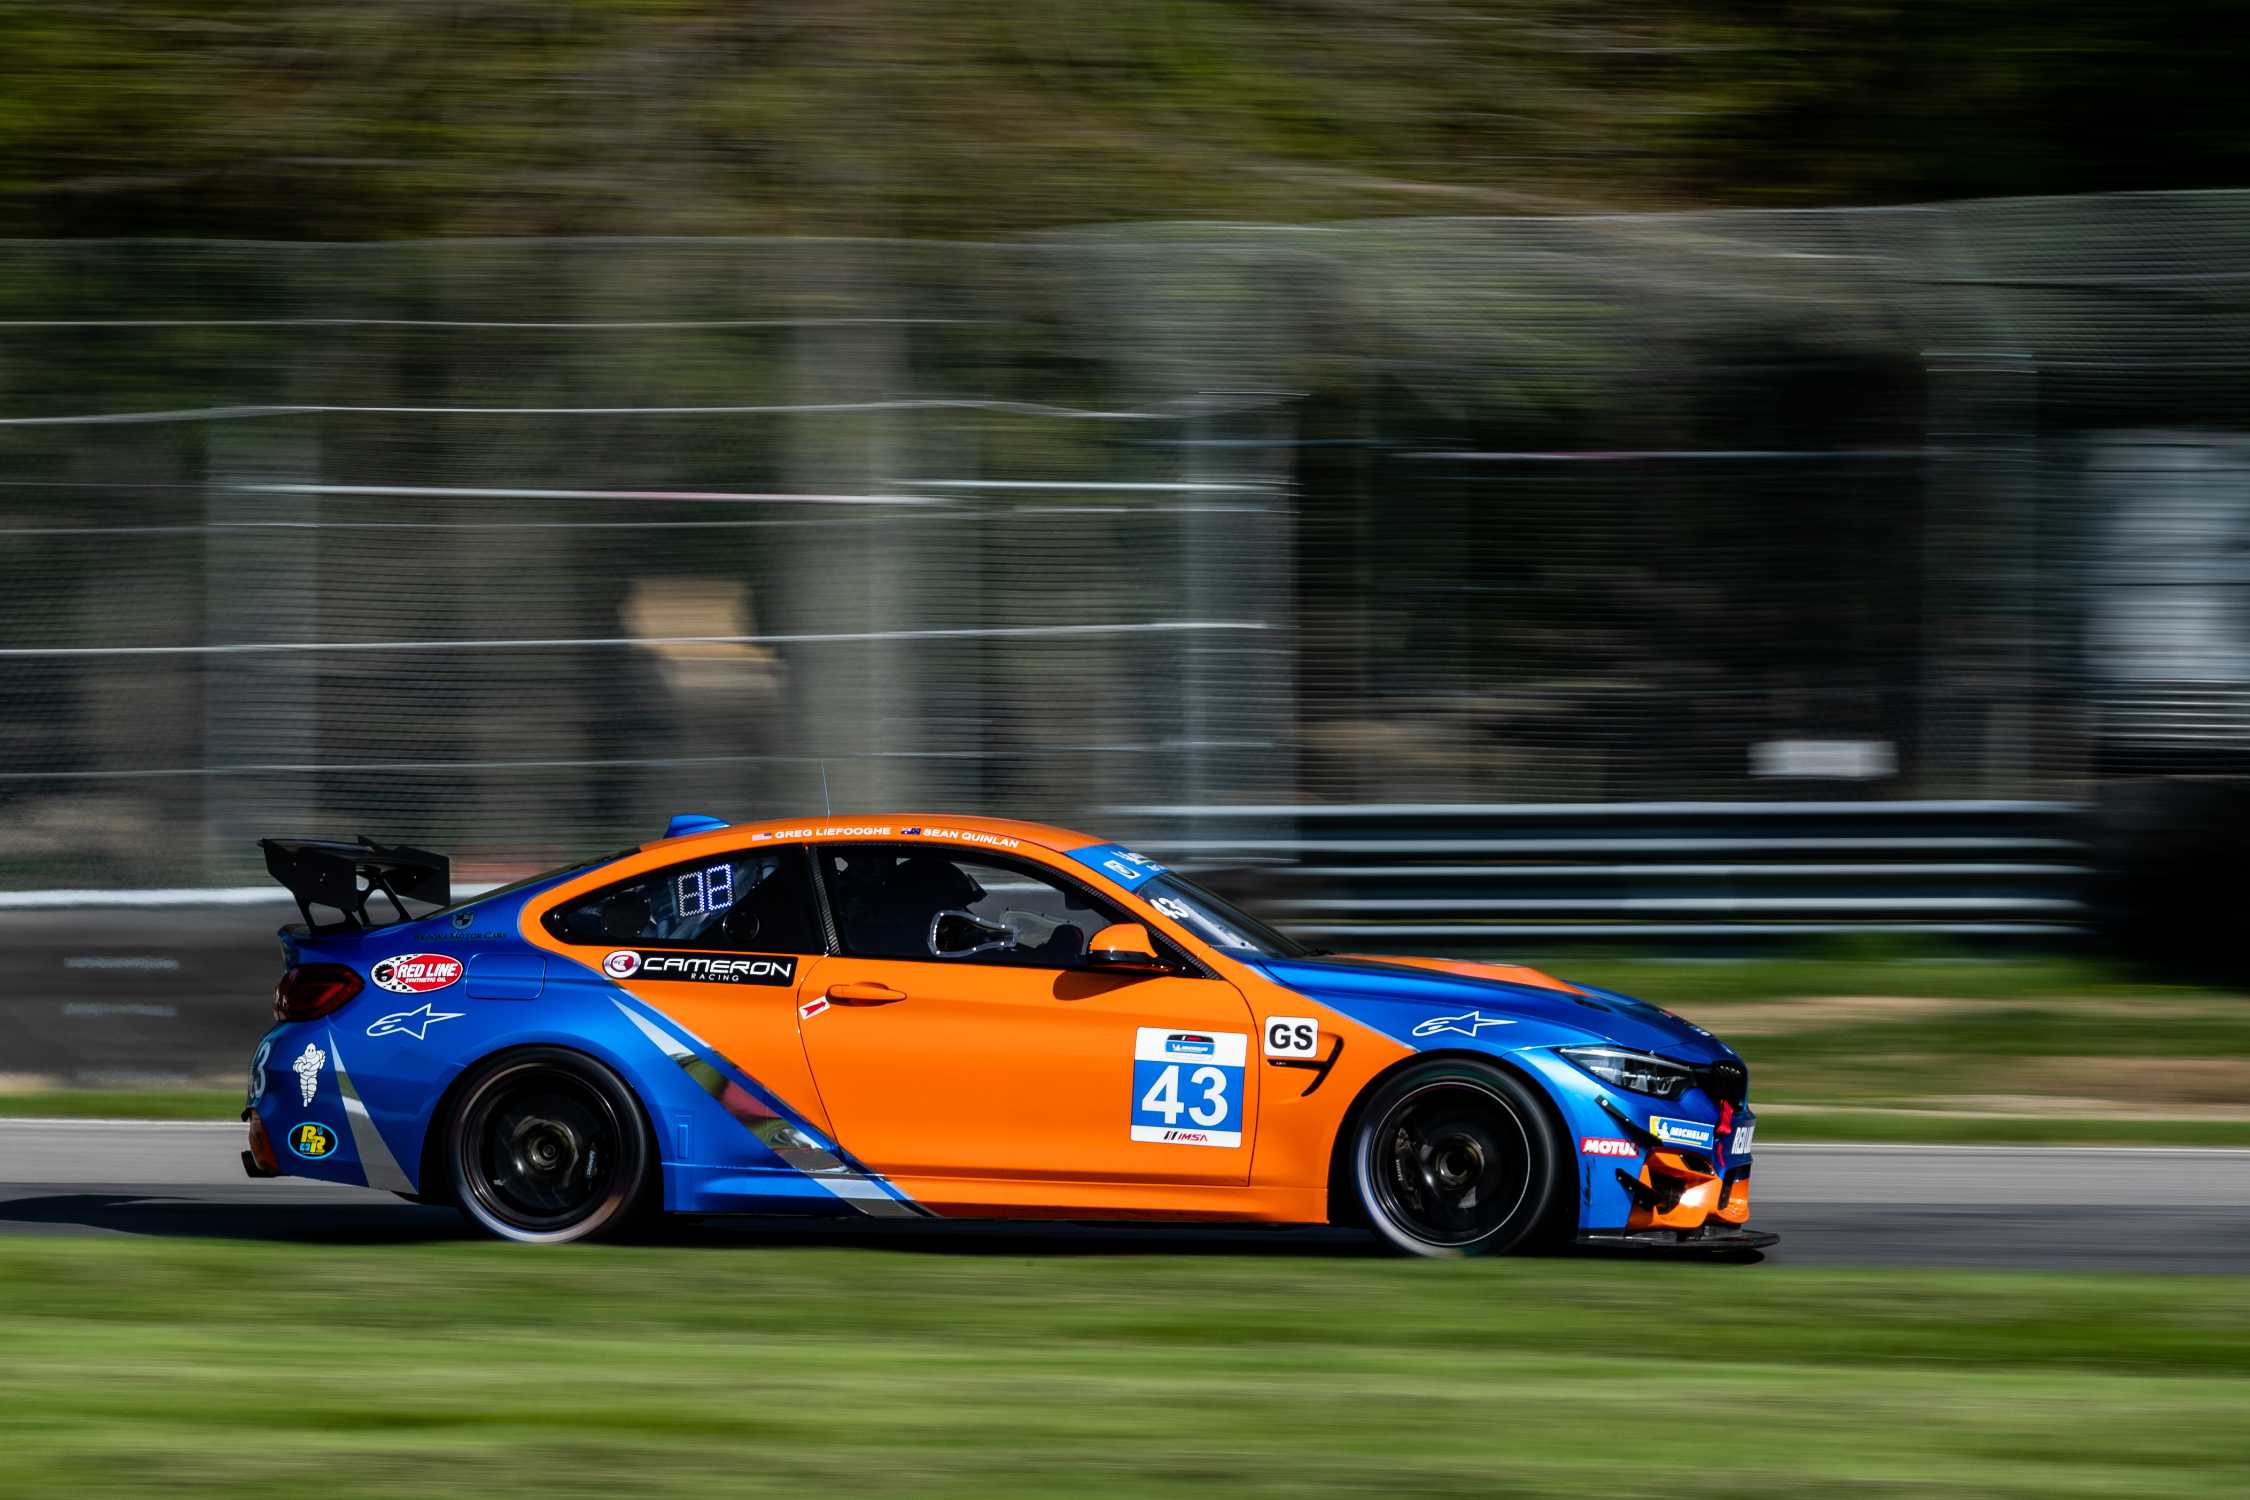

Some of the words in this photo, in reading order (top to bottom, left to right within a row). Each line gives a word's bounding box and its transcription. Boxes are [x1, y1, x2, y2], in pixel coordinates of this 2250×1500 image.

[775, 829, 812, 839] GREG
[816, 827, 891, 836] LIEFOOGHE
[923, 828, 960, 839] SEAN
[962, 832, 1019, 848] QUINLAN
[1150, 897, 1189, 919] 43
[398, 963, 424, 978] RED
[643, 957, 792, 978] CAMERON
[690, 973, 740, 982] RACING
[1269, 1023, 1313, 1051] GS
[1142, 1065, 1228, 1126] 43
[1669, 1126, 1710, 1142] MICHELIN
[1582, 1139, 1637, 1156] MOTUL
